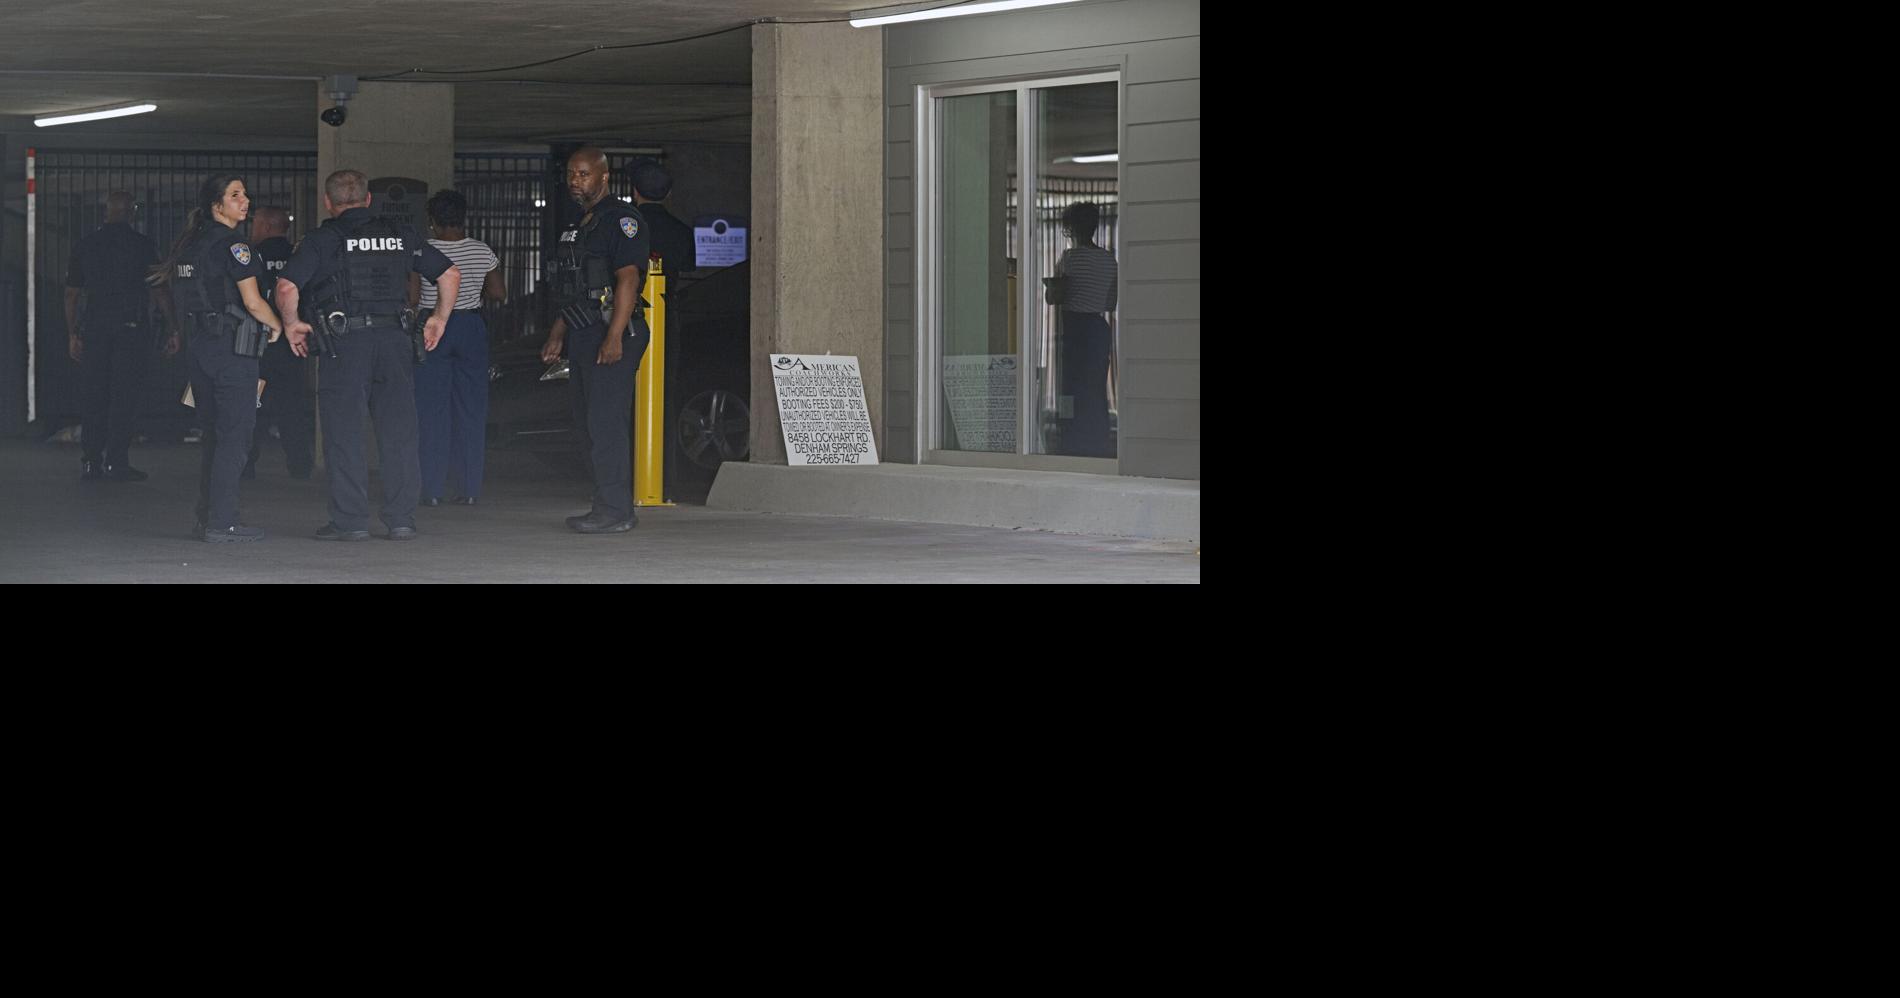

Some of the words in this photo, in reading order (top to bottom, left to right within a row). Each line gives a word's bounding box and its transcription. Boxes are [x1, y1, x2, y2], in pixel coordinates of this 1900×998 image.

[346, 237, 404, 252] POLICE
[789, 357, 856, 371] AMERICAN
[774, 376, 795, 387] TOWING
[813, 376, 836, 387] BOOTING
[836, 376, 862, 388] ENFORCED
[779, 386, 818, 398] AUTHORIZED
[818, 387, 847, 398] VEHICLES
[847, 387, 862, 398] ONLY
[782, 399, 812, 410] BOOTING
[812, 399, 830, 410] FEES
[830, 399, 845, 410] $200
[848, 399, 863, 410] $750
[781, 410, 822, 421] UNAUTHORIZED
[821, 410, 846, 421] VEHICLES
[846, 410, 859, 421] WILL
[858, 410, 868, 421] BE
[782, 421, 799, 432] TOWED
[799, 421, 807, 432] OR
[787, 432, 810, 443] 8458
[811, 432, 855, 443] LOCKHART
[856, 432, 871, 443] RD.
[794, 443, 831, 454] DENHAM
[831, 443, 868, 453] SPRINGS
[805, 453, 860, 465] 225-665-7427
